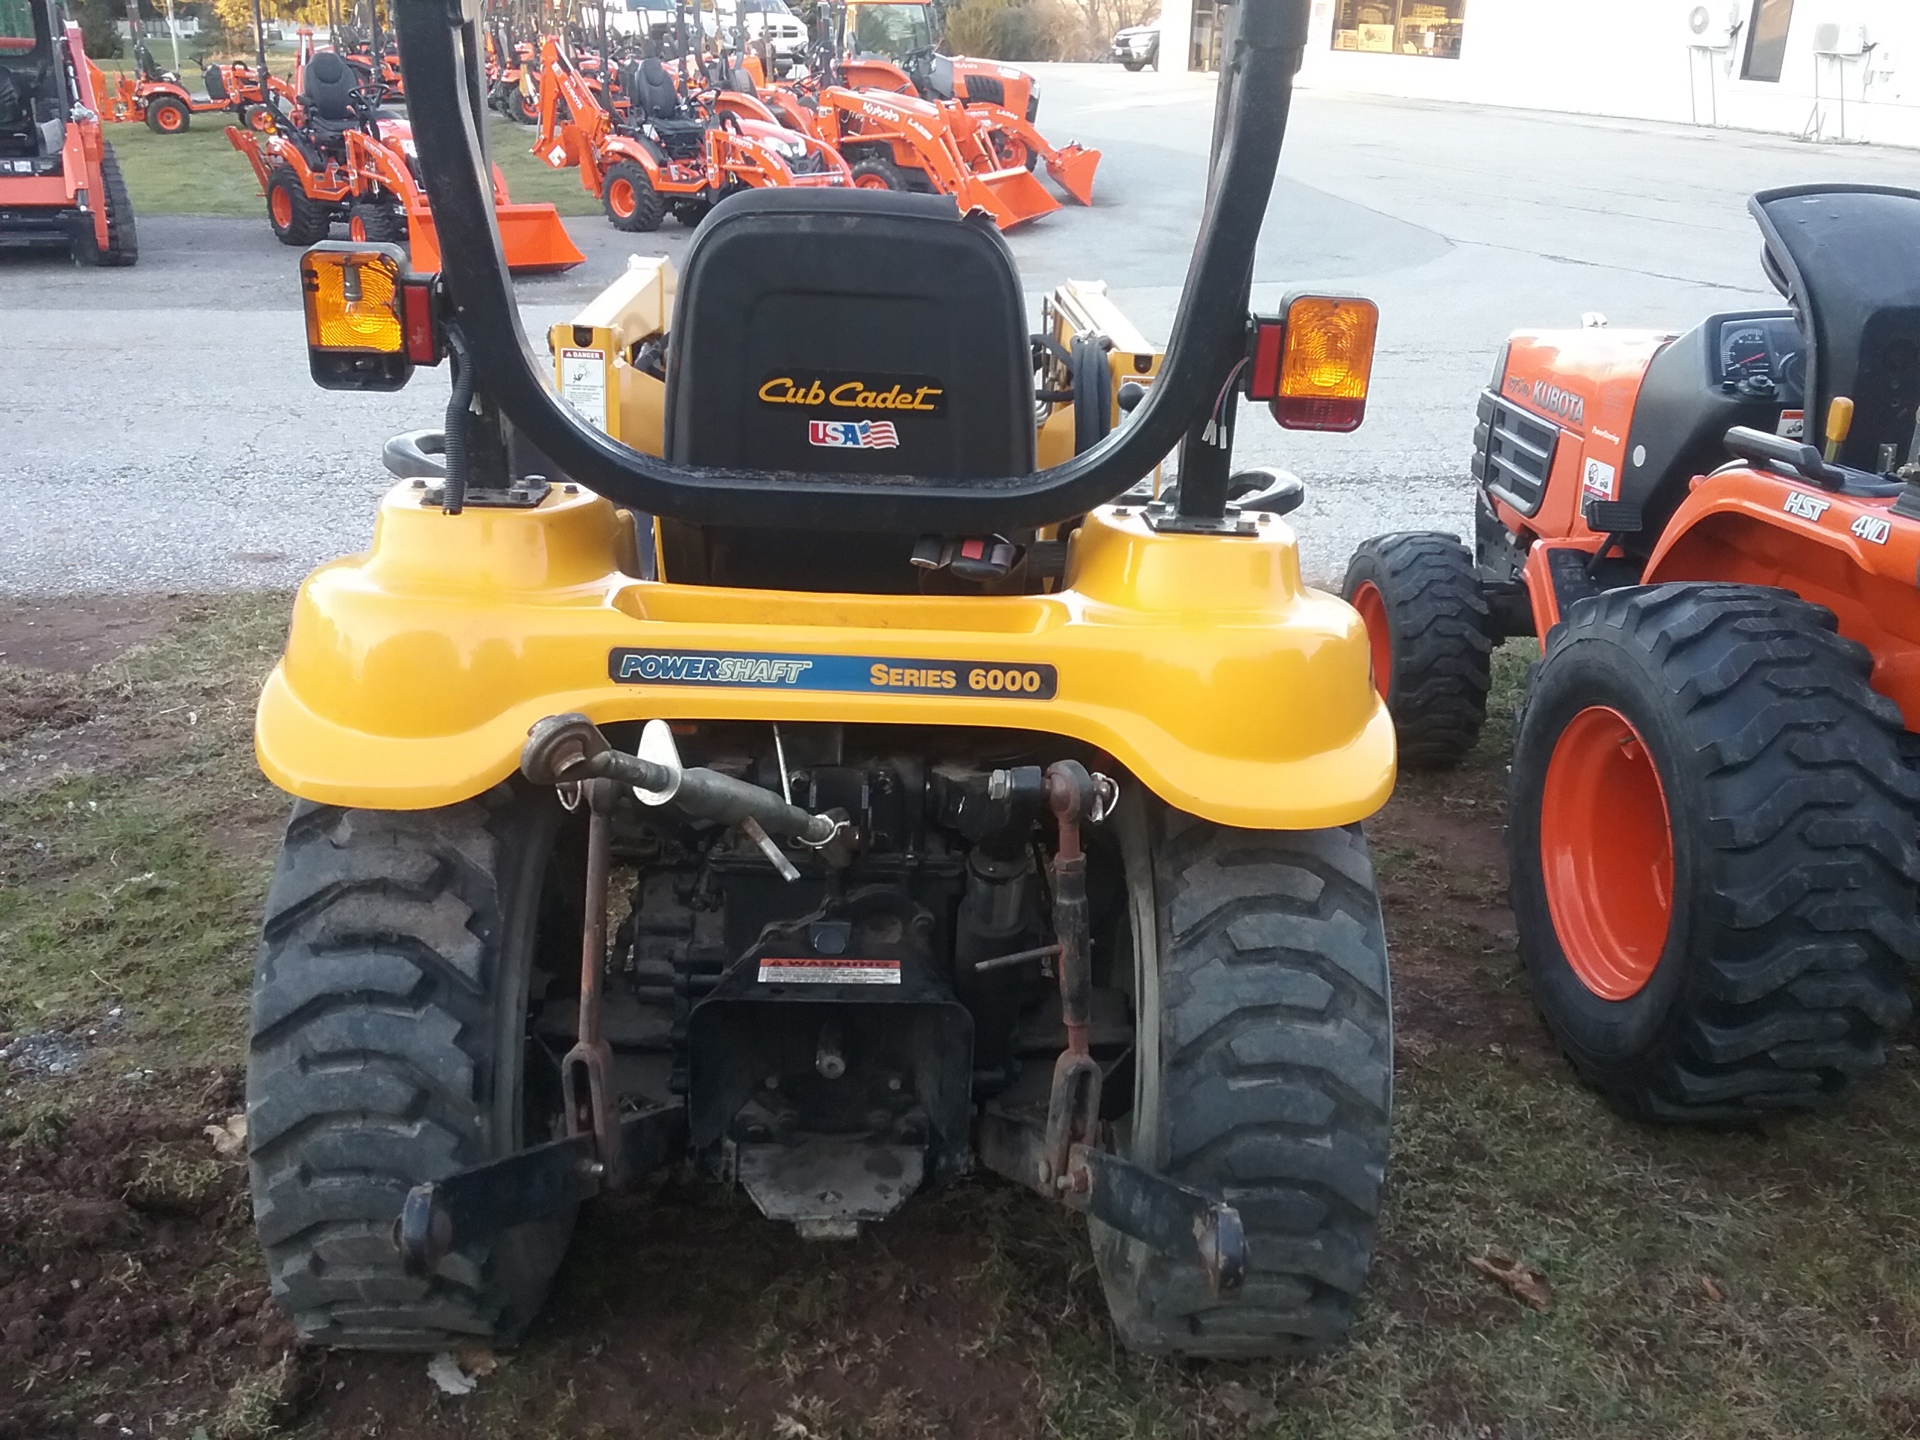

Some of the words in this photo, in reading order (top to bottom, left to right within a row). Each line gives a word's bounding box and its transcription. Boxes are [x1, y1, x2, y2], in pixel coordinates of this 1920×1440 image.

[563, 80, 583, 110] KUBOTA
[862, 101, 900, 122] Kubota
[572, 351, 600, 359] DANGER
[758, 377, 826, 405] Cub
[828, 381, 943, 410] Cadet
[1532, 379, 1585, 426] KUBOTA
[809, 420, 863, 447] USA
[1782, 491, 1831, 522] HST
[1850, 513, 1892, 546] 4WD
[619, 655, 805, 684] POWERSHAFT
[968, 668, 1041, 692] 6000
[788, 960, 891, 968] WARNING
